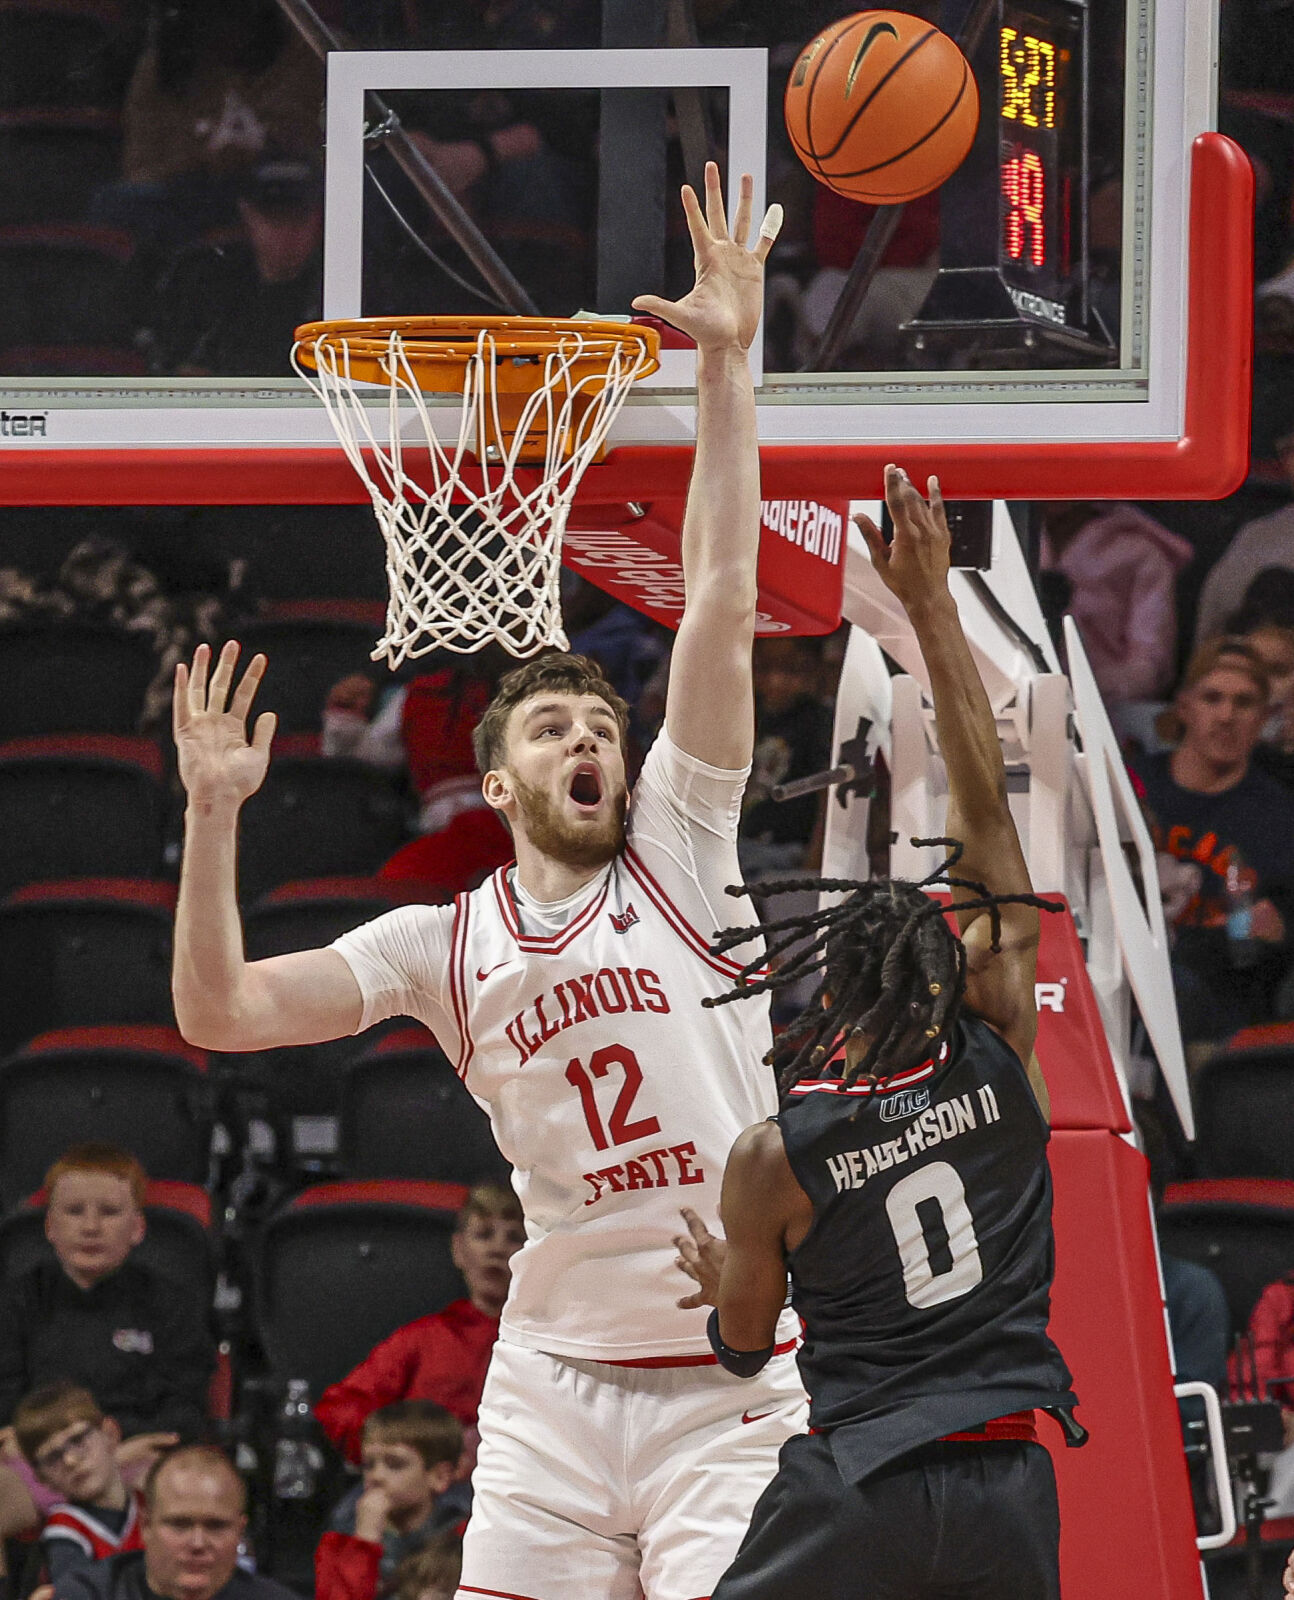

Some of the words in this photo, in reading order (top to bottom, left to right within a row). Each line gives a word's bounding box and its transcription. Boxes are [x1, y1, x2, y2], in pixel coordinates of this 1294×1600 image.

[504, 967, 670, 1067] ILLINOIS
[565, 1043, 661, 1151] 12
[880, 1089, 930, 1123] UTC
[582, 1141, 704, 1206] STATE
[885, 1162, 983, 1309] 0
